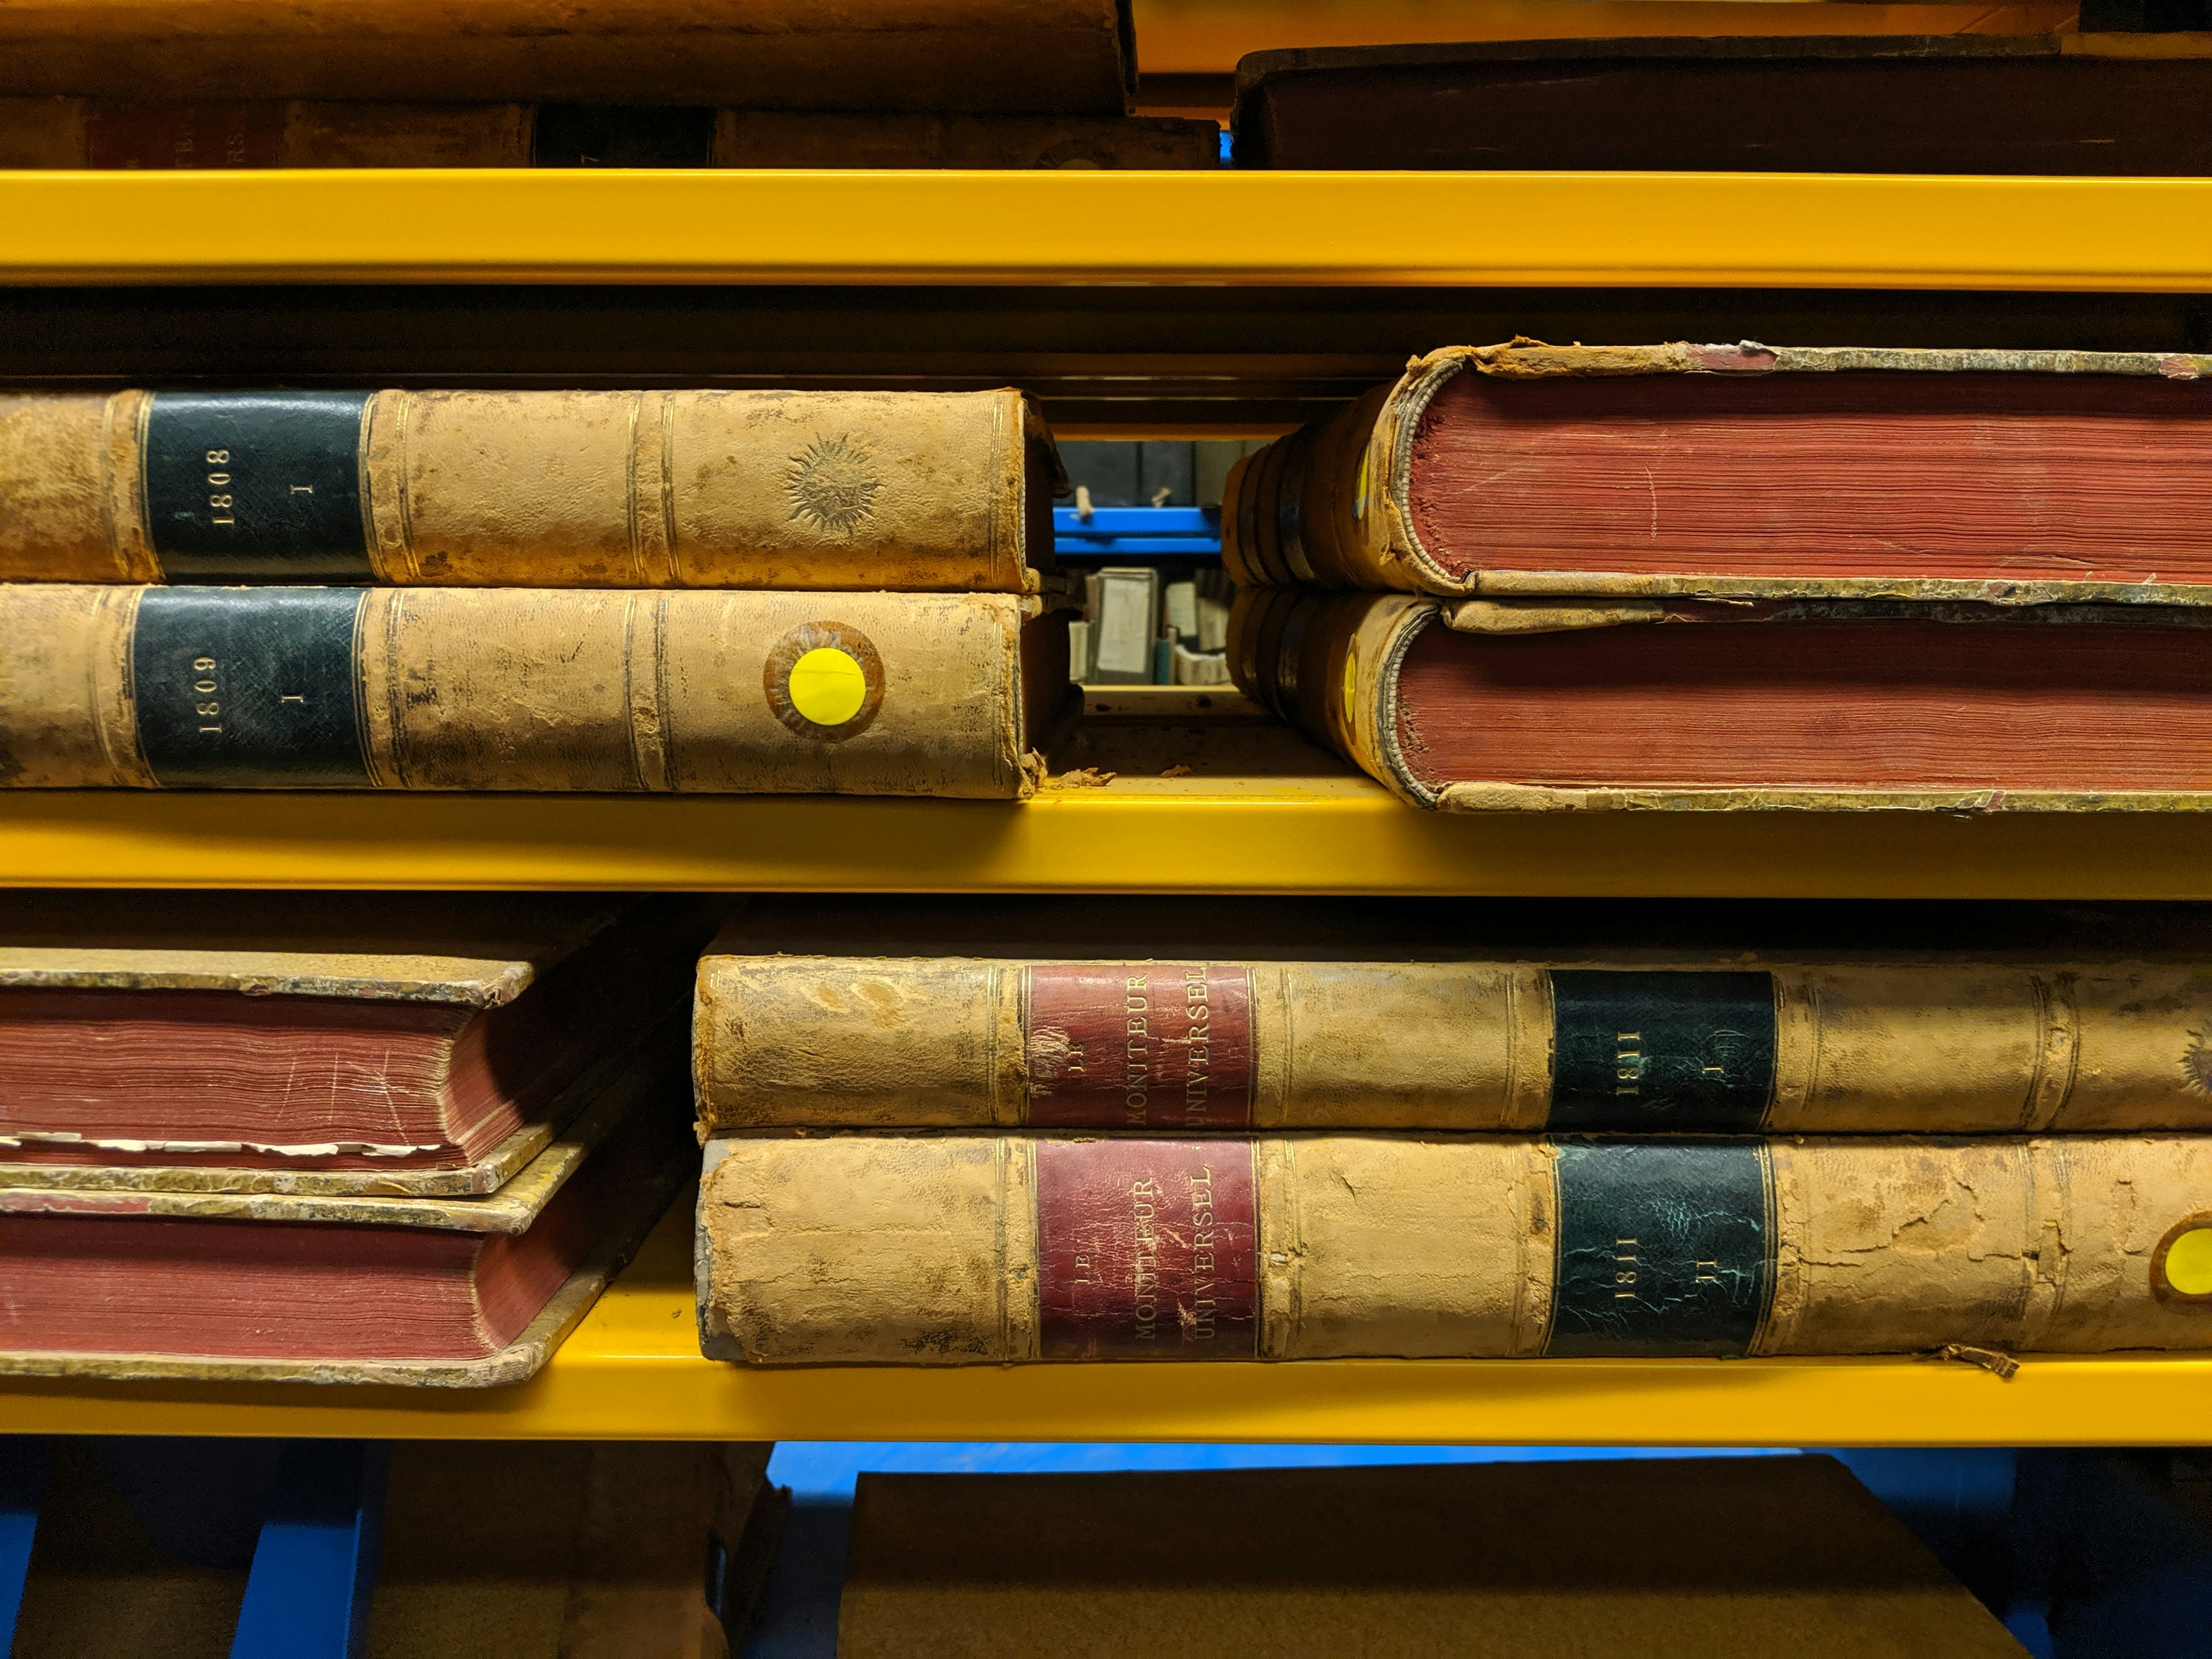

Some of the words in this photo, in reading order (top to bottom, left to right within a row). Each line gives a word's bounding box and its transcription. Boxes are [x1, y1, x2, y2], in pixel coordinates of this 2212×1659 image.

[206, 449, 235, 525] 1808
[194, 657, 222, 733] 1809
[1068, 1042, 1086, 1071] LE
[1126, 973, 1149, 1125] MONITEUR
[1185, 967, 1209, 1127] UNIVERSEL
[1616, 1031, 1640, 1096] 1811
[1075, 1254, 1091, 1284] LE
[1133, 1176, 1157, 1340] MONITEUR
[1190, 1163, 1216, 1340] UNIVERSEL
[1615, 1238, 1637, 1298] 1811
[1695, 1260, 1717, 1284] II
